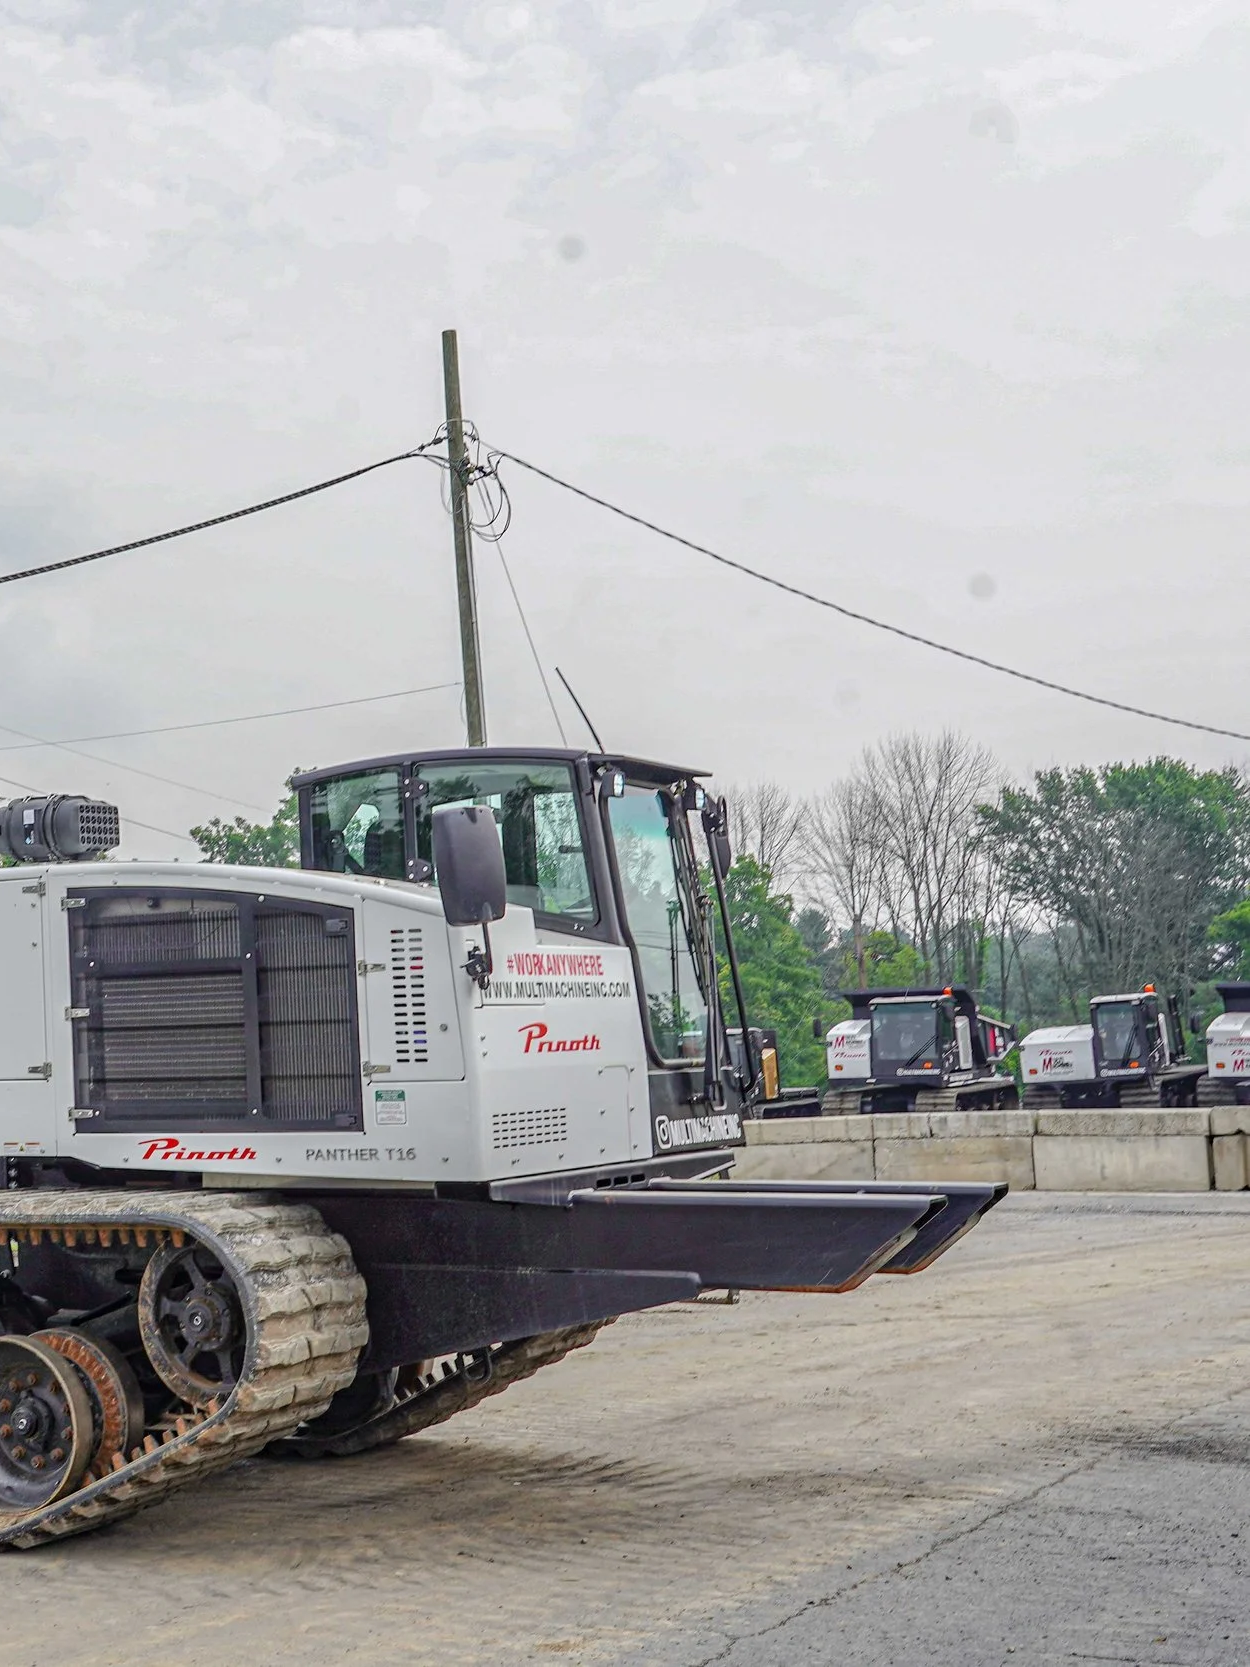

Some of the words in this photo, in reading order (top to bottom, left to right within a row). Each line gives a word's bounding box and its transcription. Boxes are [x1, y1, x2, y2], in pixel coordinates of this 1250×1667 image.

[507, 953, 604, 976] #WORKANYWHERE
[483, 981, 631, 999] WWW.MULTIMACHINEINC.COM
[138, 1138, 257, 1160] Prinoth
[306, 1148, 380, 1161] PANTHER
[386, 1148, 417, 1161] T16
